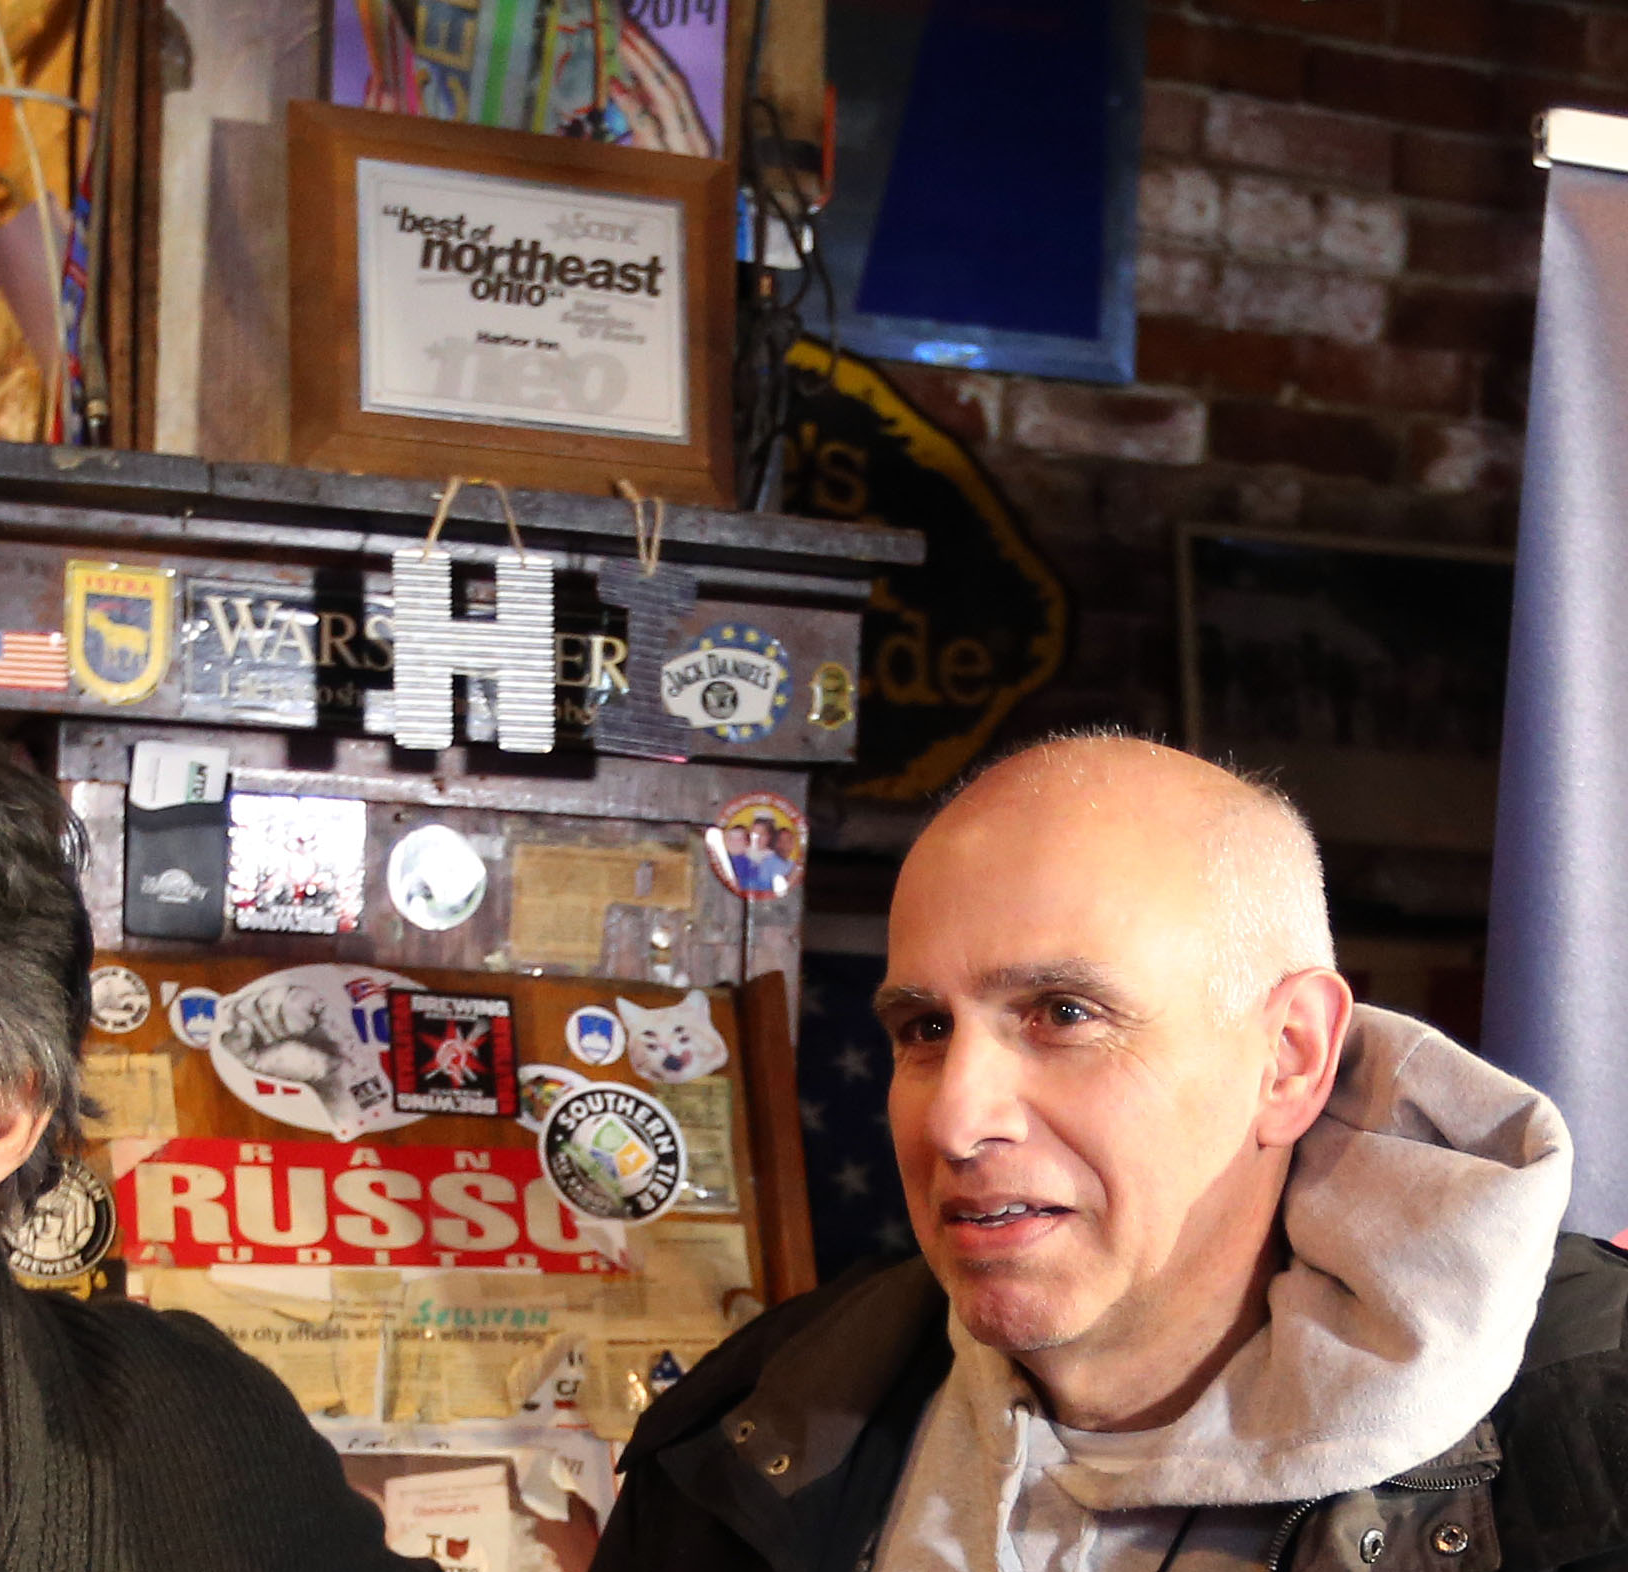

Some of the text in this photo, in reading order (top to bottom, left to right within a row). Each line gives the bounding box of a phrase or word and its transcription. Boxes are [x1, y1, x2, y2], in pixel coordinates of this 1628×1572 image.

[420, 236, 664, 298] northeast
[556, 1091, 676, 1154] SOUTHERN
[636, 1164, 678, 1211] TIER
[9, 1249, 84, 1276] BREWERY
[137, 1244, 614, 1272] AUDITOR
